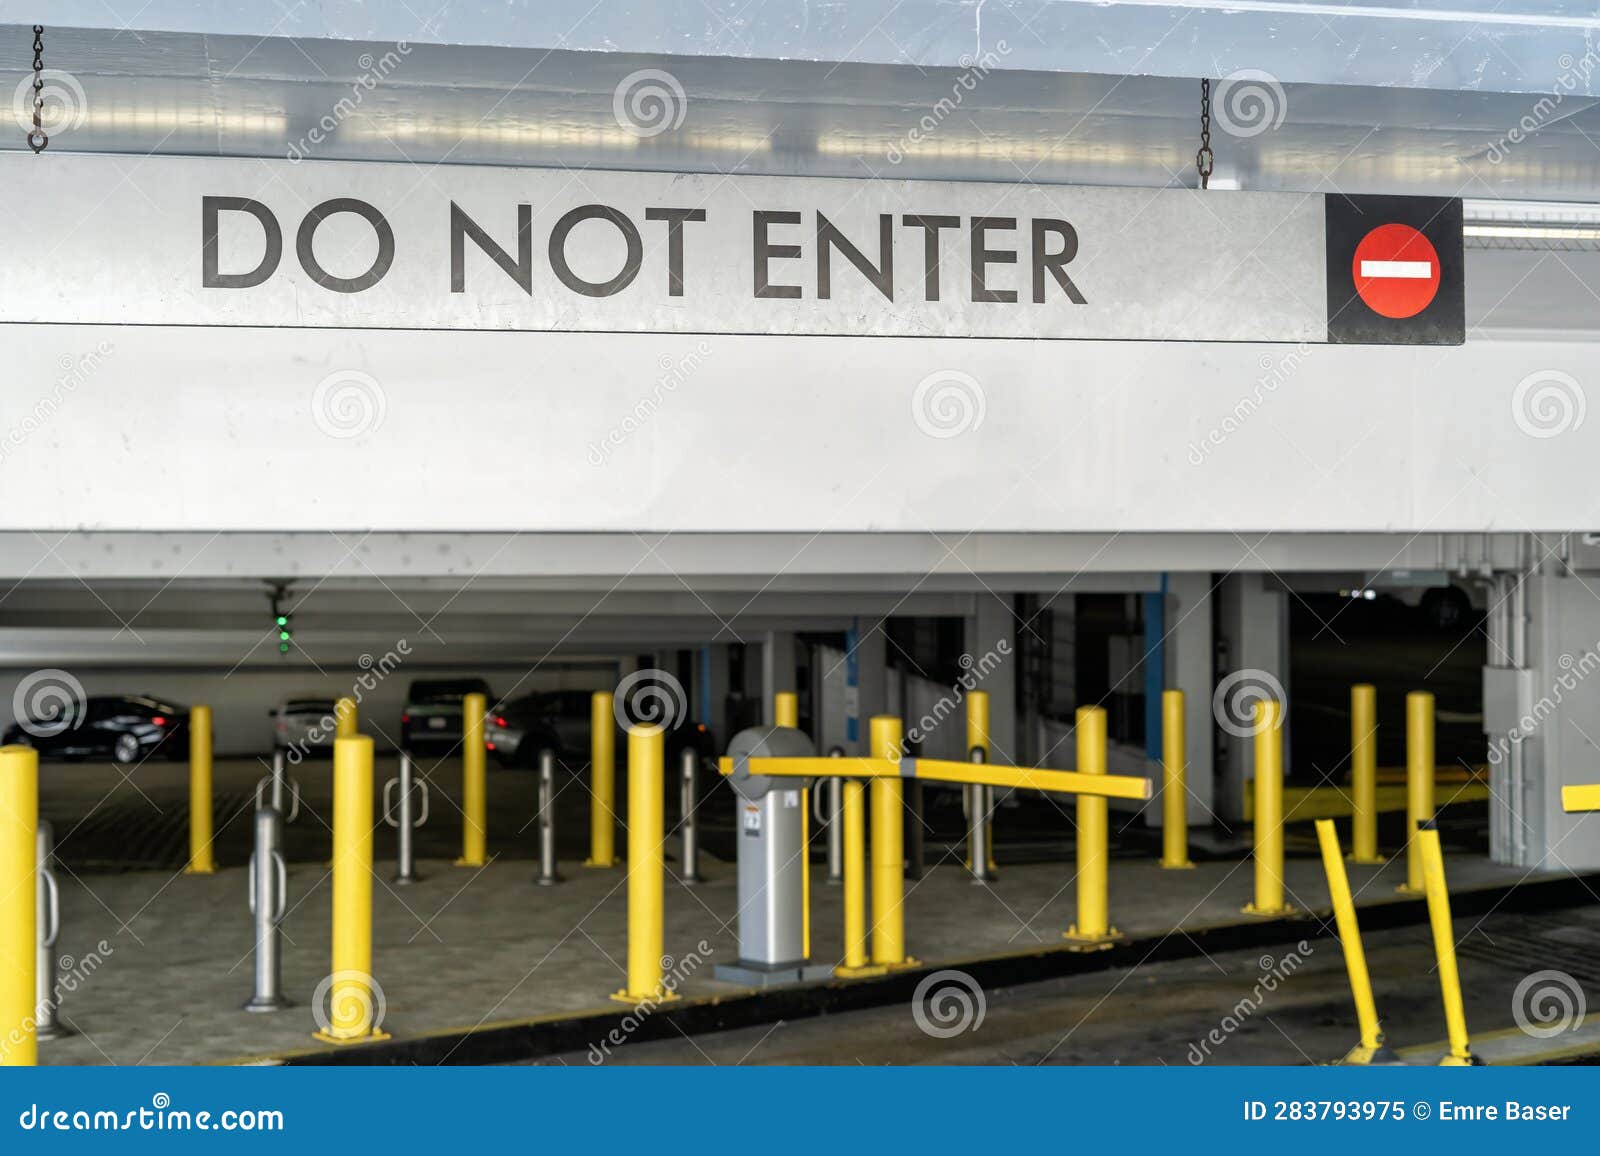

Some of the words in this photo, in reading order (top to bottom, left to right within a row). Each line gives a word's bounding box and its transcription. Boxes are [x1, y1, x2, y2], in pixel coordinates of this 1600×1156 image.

[202, 195, 396, 294] DO
[450, 200, 707, 298] NOT
[753, 208, 1089, 306] ENTER
